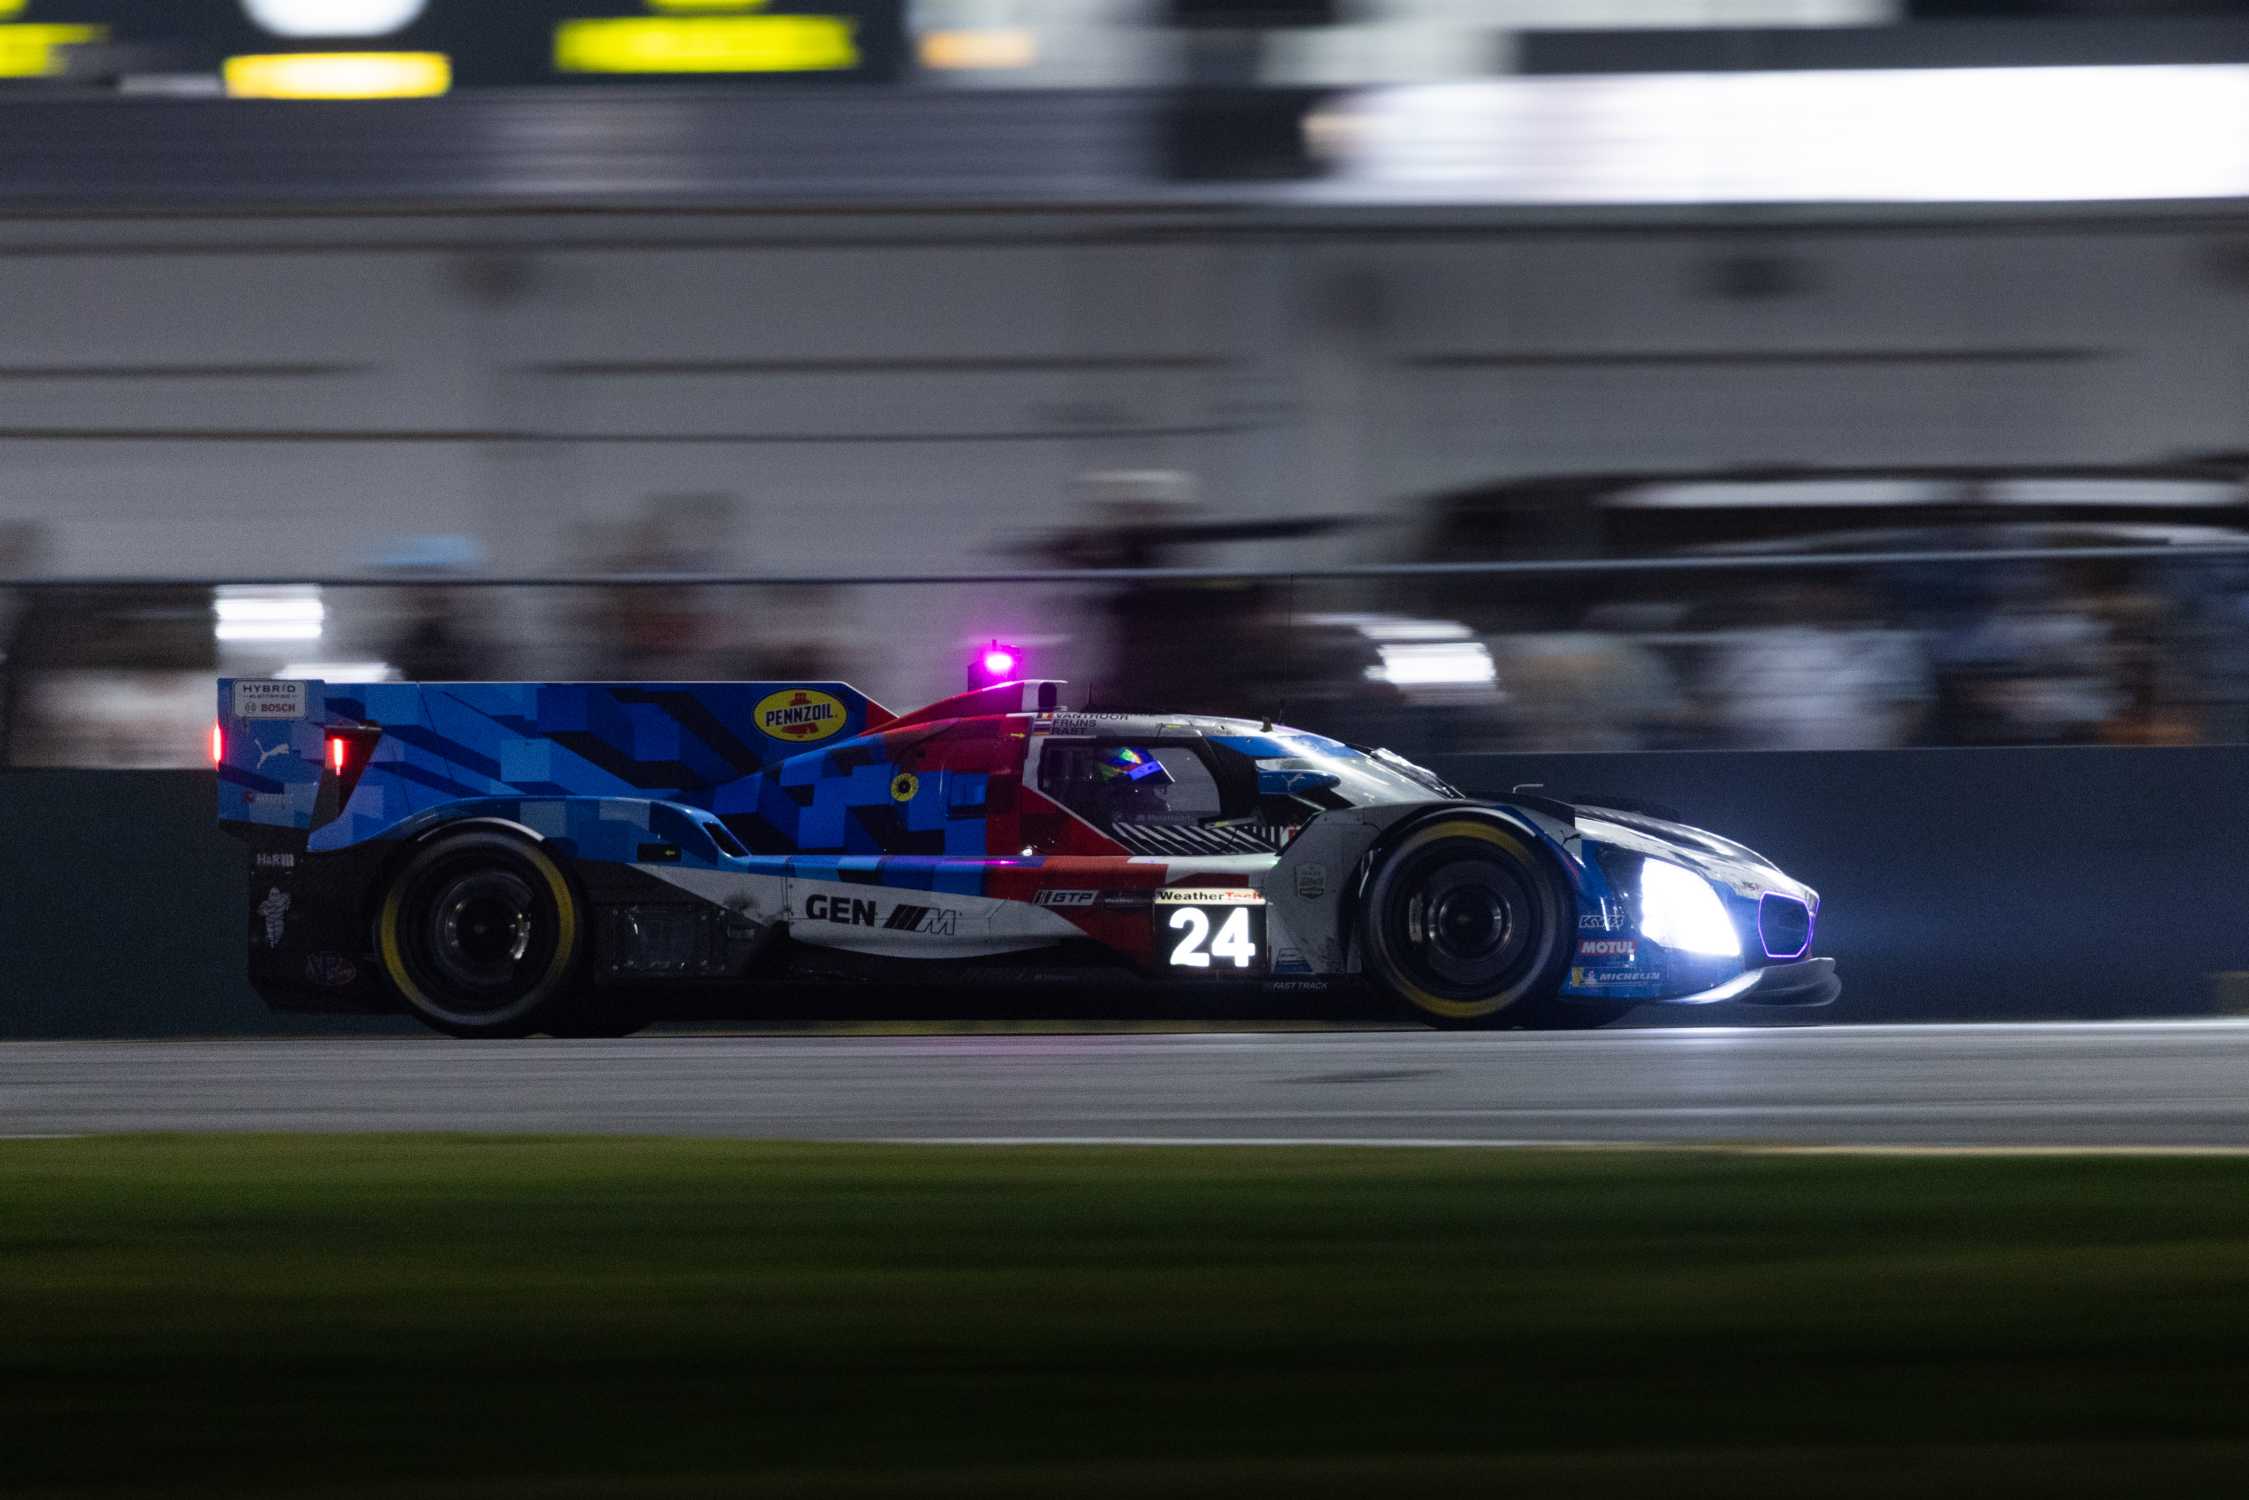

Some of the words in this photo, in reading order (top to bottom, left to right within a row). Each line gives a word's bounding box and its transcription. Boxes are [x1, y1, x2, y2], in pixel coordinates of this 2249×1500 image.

[243, 685, 296, 693] HYBRID
[261, 703, 295, 712] BOSCH
[766, 703, 833, 727] PENNZOIL
[1052, 892, 1093, 903] GTP
[1160, 891, 1262, 901] WeatherTech
[805, 894, 876, 927] GEN
[1169, 907, 1256, 967] 24
[1582, 941, 1633, 954] MOTUL
[1600, 972, 1660, 981] MICHELIN
